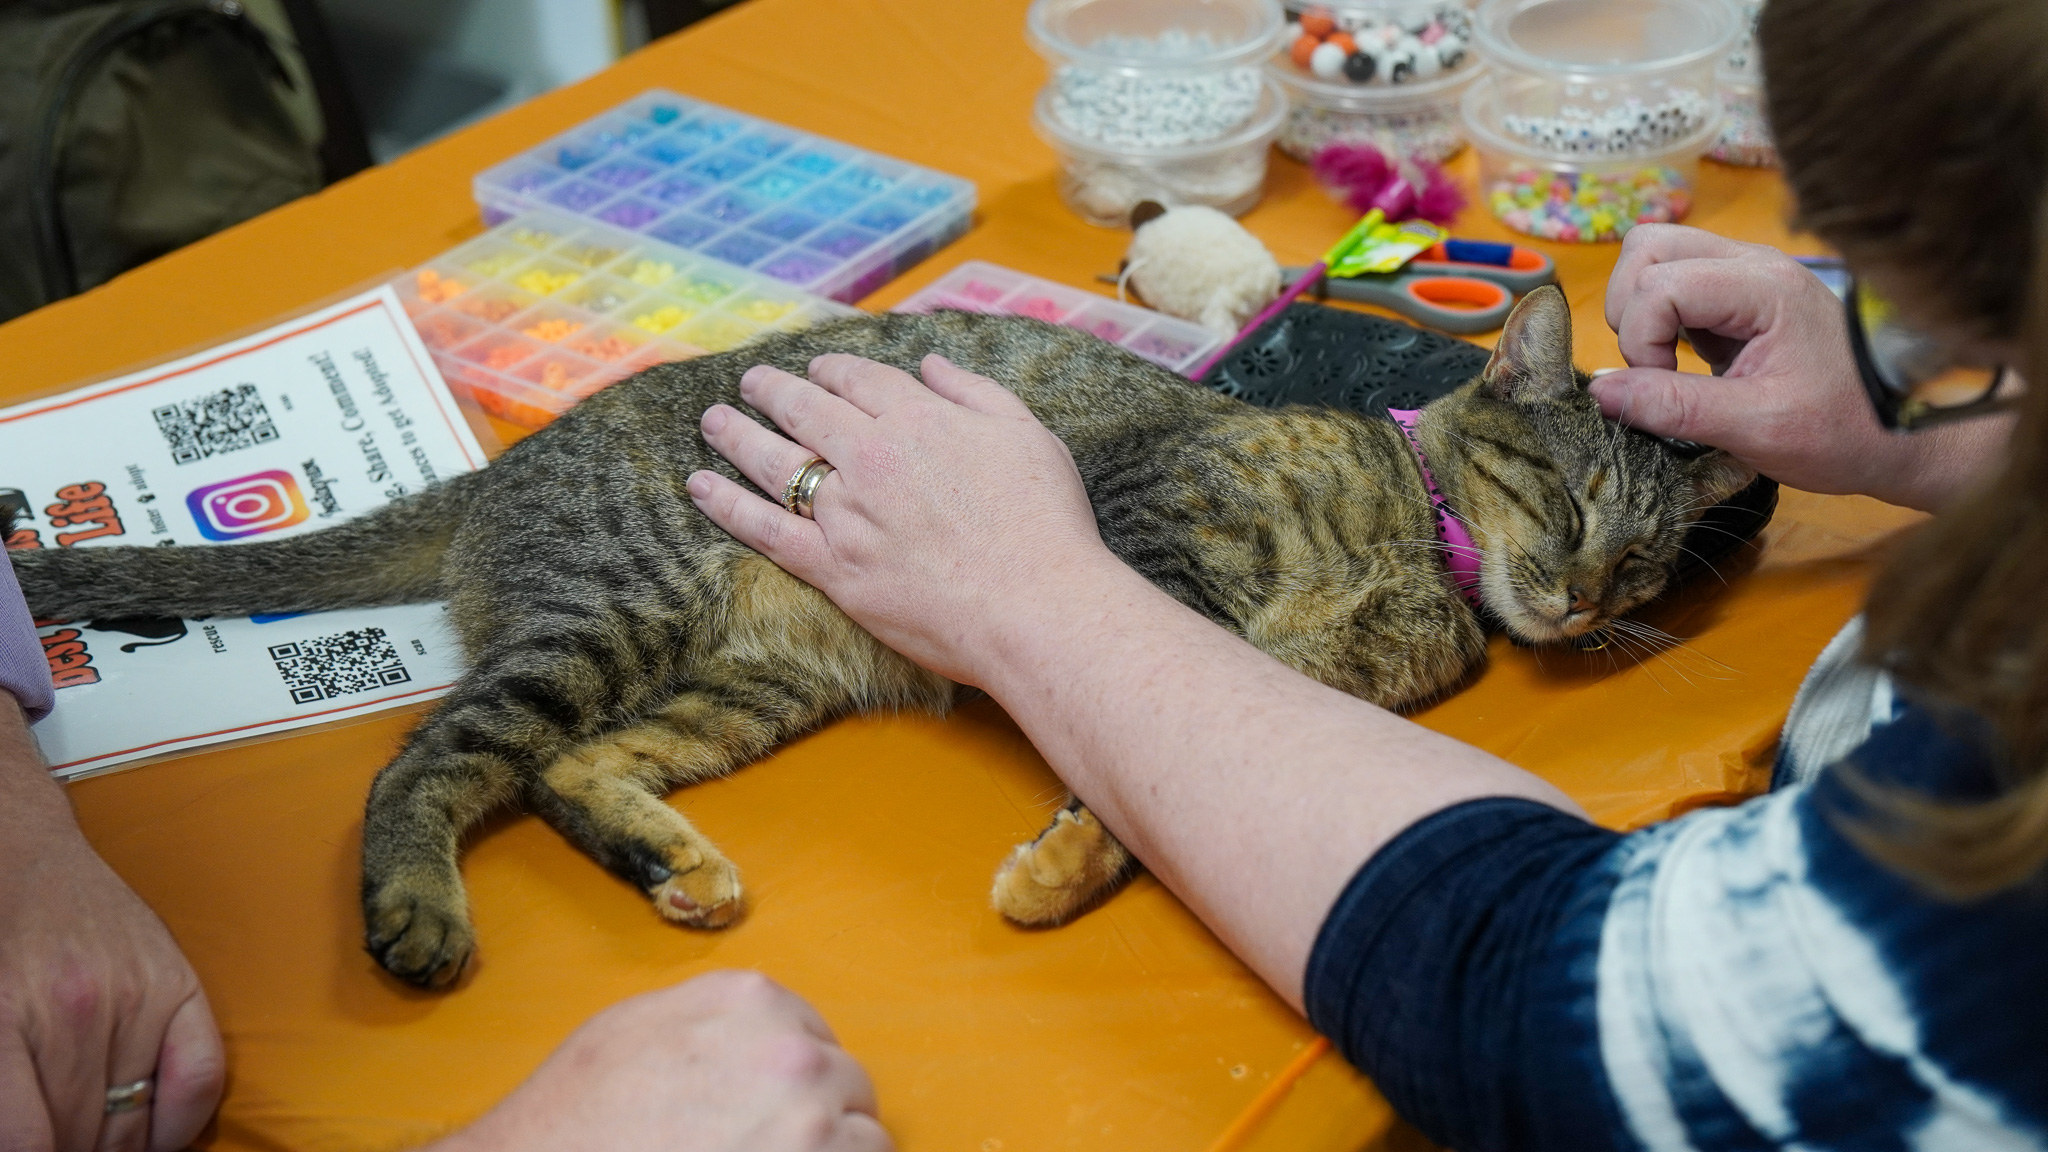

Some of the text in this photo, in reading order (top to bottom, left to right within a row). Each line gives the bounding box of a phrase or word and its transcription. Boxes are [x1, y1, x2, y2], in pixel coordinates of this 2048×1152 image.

[307, 350, 365, 432] Comment!
[352, 346, 396, 406] Adopted!
[387, 408, 414, 430] get
[401, 430, 417, 446] to
[358, 431, 394, 483] Share,
[45, 480, 126, 546] Life
[301, 457, 342, 519] Instagram
[125, 464, 227, 654] rescue foster adopt
[410, 639, 427, 655] scan
